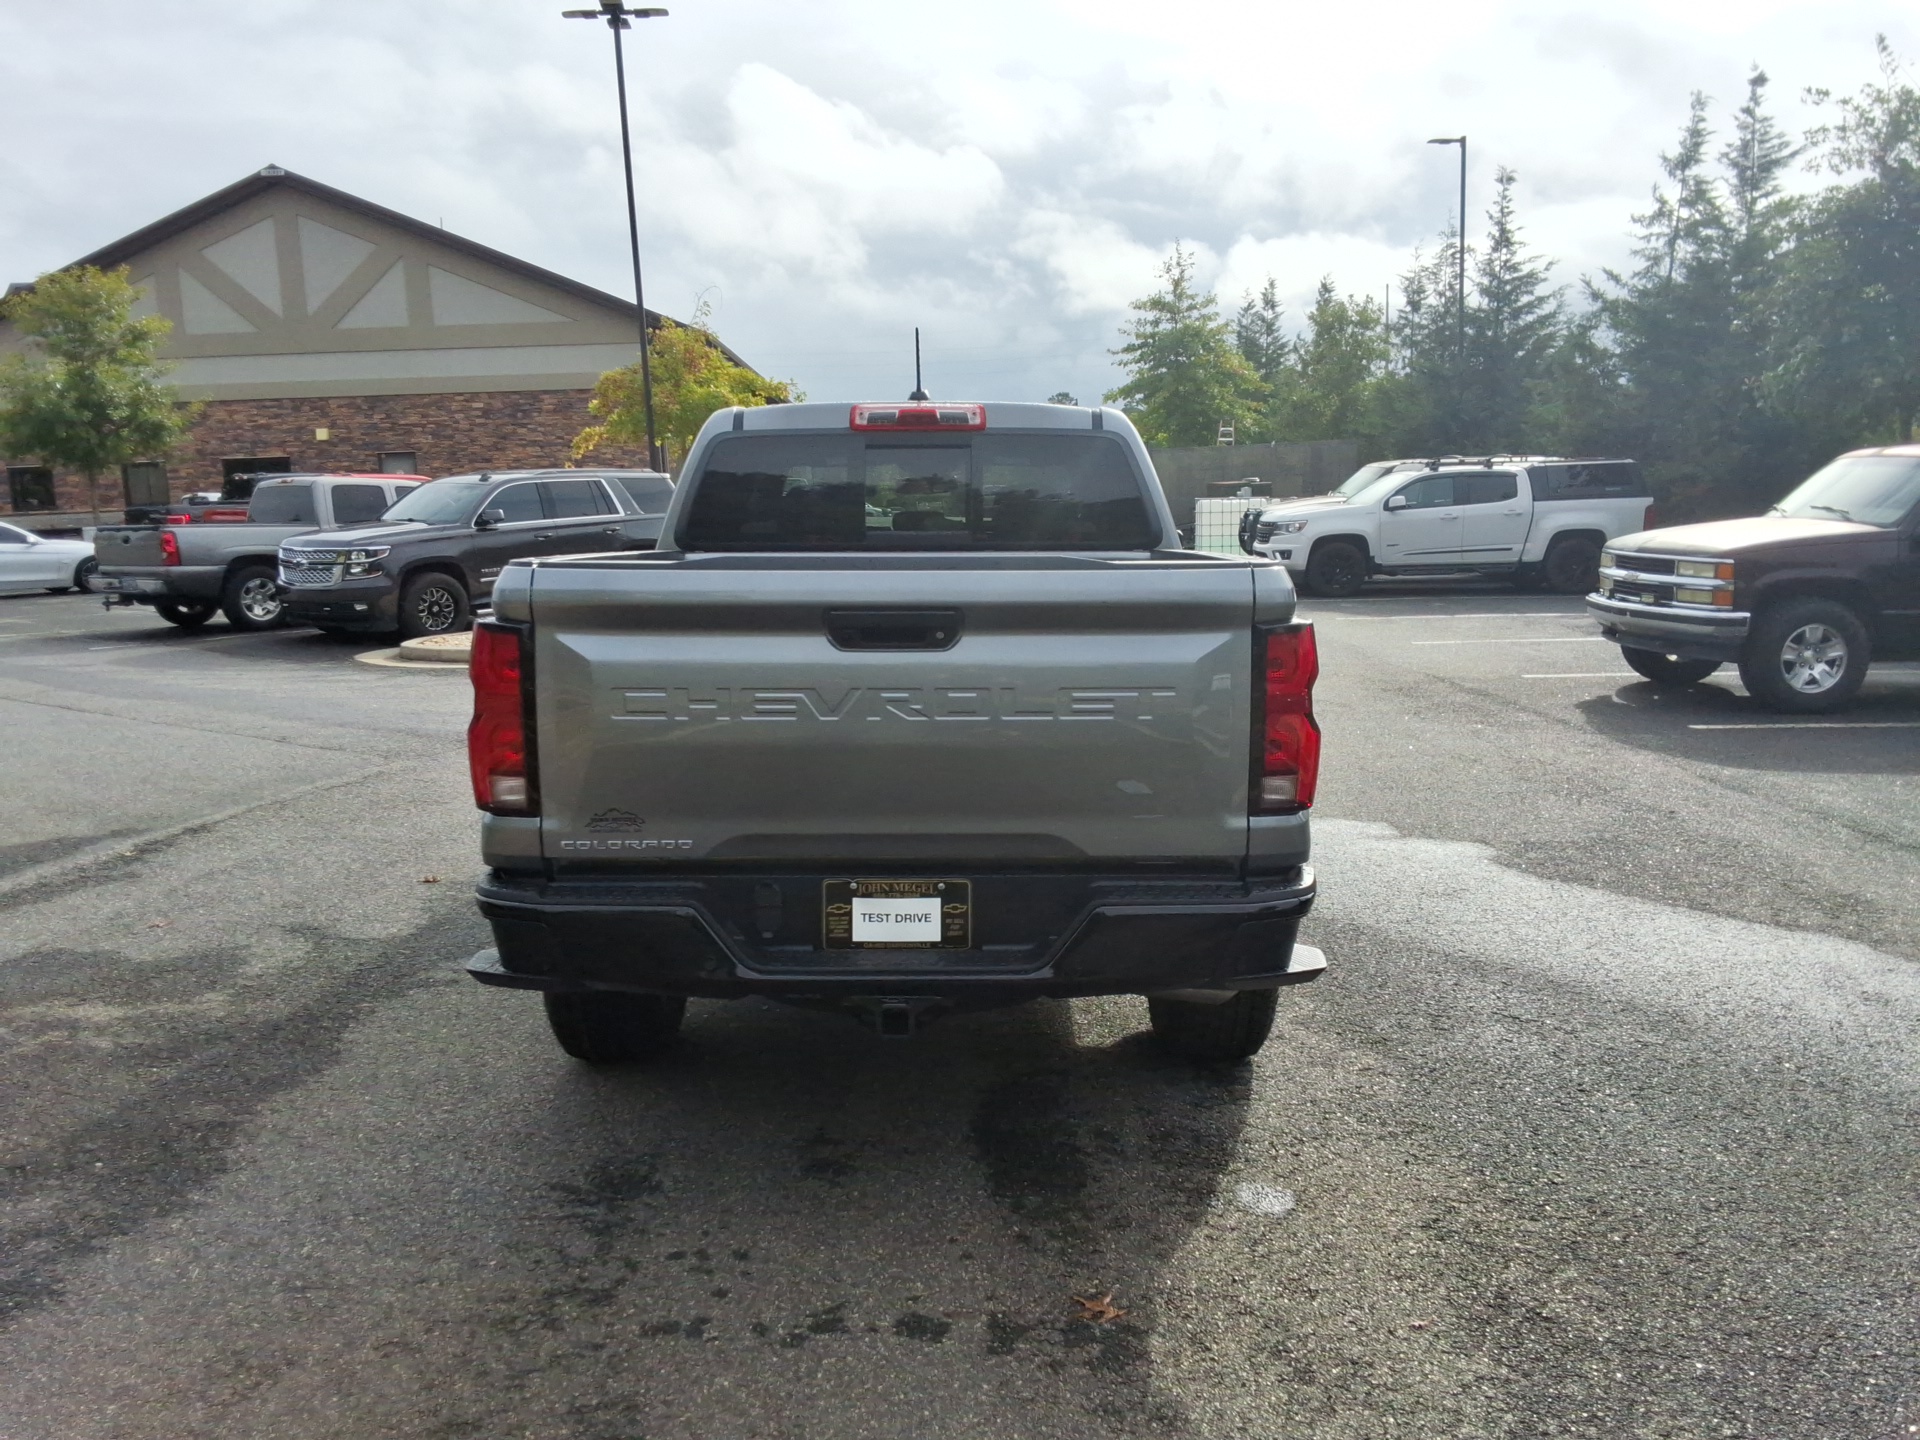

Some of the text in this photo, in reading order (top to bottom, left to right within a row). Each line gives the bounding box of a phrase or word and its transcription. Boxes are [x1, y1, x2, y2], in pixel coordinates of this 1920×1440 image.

[610, 687, 1176, 720] CHEVROLET
[560, 839, 693, 850] COLORADO
[857, 883, 890, 895] JOHN
[892, 883, 937, 895] MEGEL
[860, 913, 932, 923] TEST DRIVE
